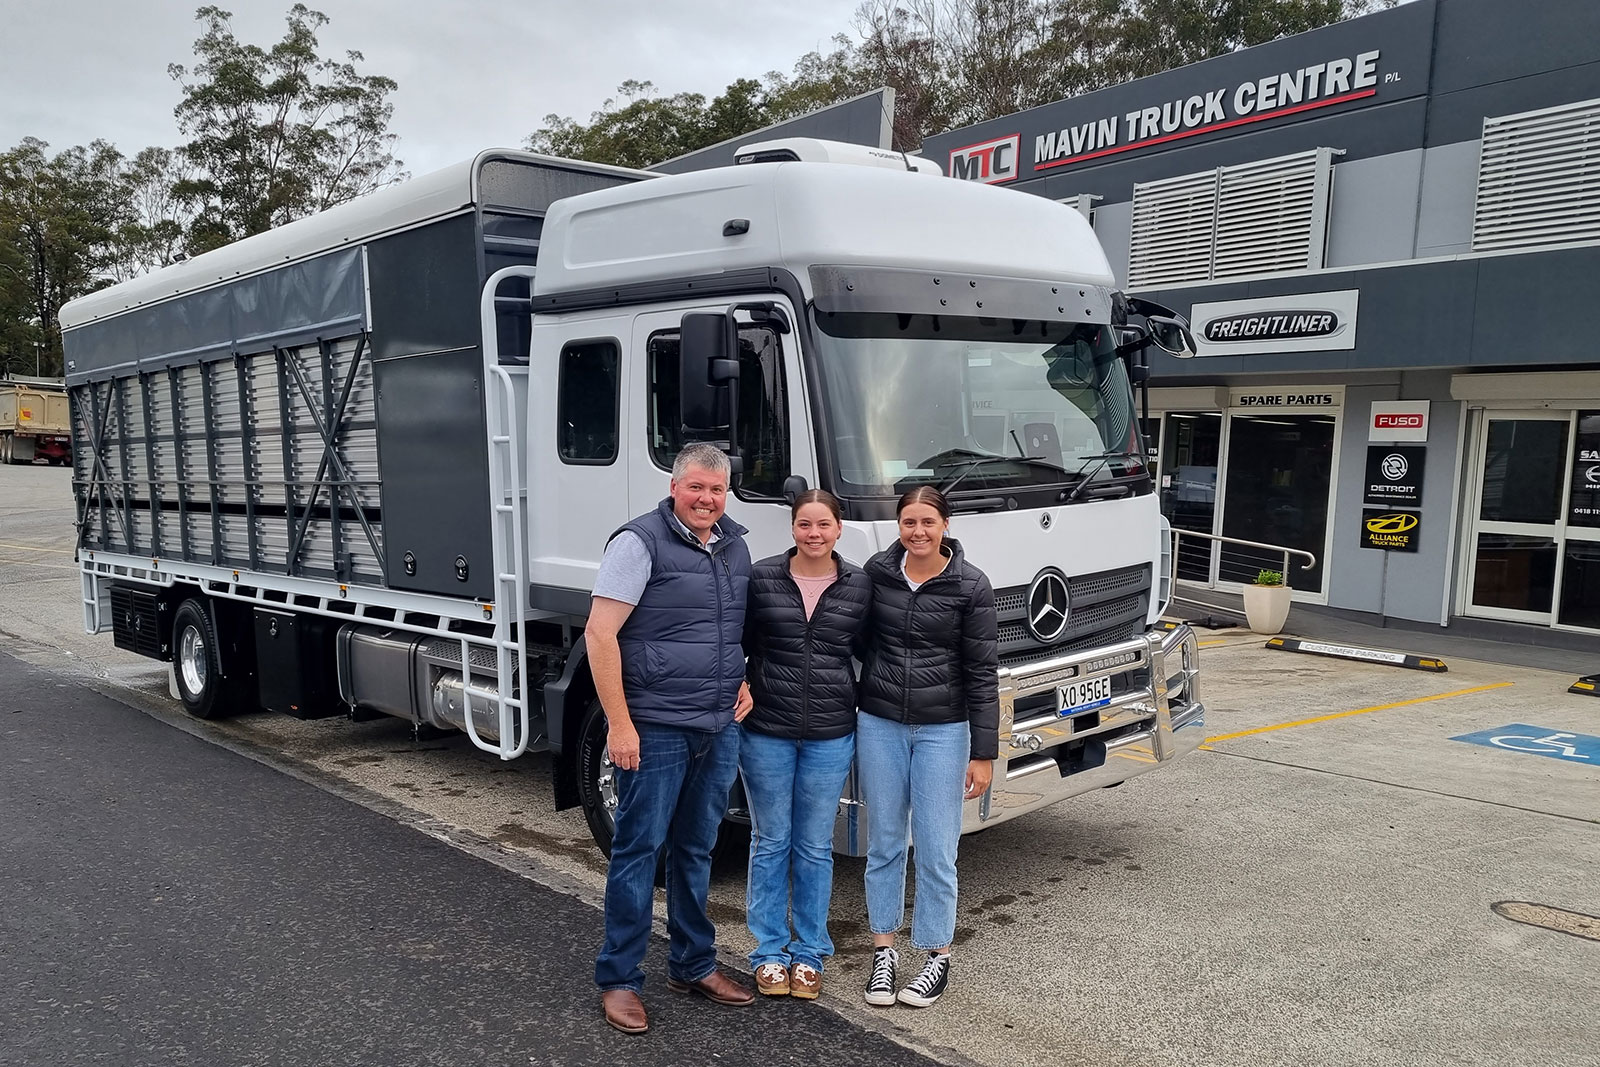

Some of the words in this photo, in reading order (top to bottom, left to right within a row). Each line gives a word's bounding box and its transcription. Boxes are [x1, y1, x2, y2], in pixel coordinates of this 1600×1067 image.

[1034, 116, 1118, 163] MAVIN
[1125, 88, 1227, 142] TRUCK
[1233, 50, 1380, 116] CENTRE
[1384, 72, 1401, 83] P/L
[953, 143, 1011, 180] MTC
[1209, 315, 1332, 338] FREIGHTLINER
[1240, 395, 1282, 406] SPARE
[1286, 394, 1332, 405] PARTS
[1379, 416, 1420, 426] FUSO
[1370, 484, 1416, 493] DETROIT
[1369, 533, 1409, 543] ALLIANCE
[1304, 643, 1354, 655] CUSTOMER
[1355, 650, 1396, 661] PARKING
